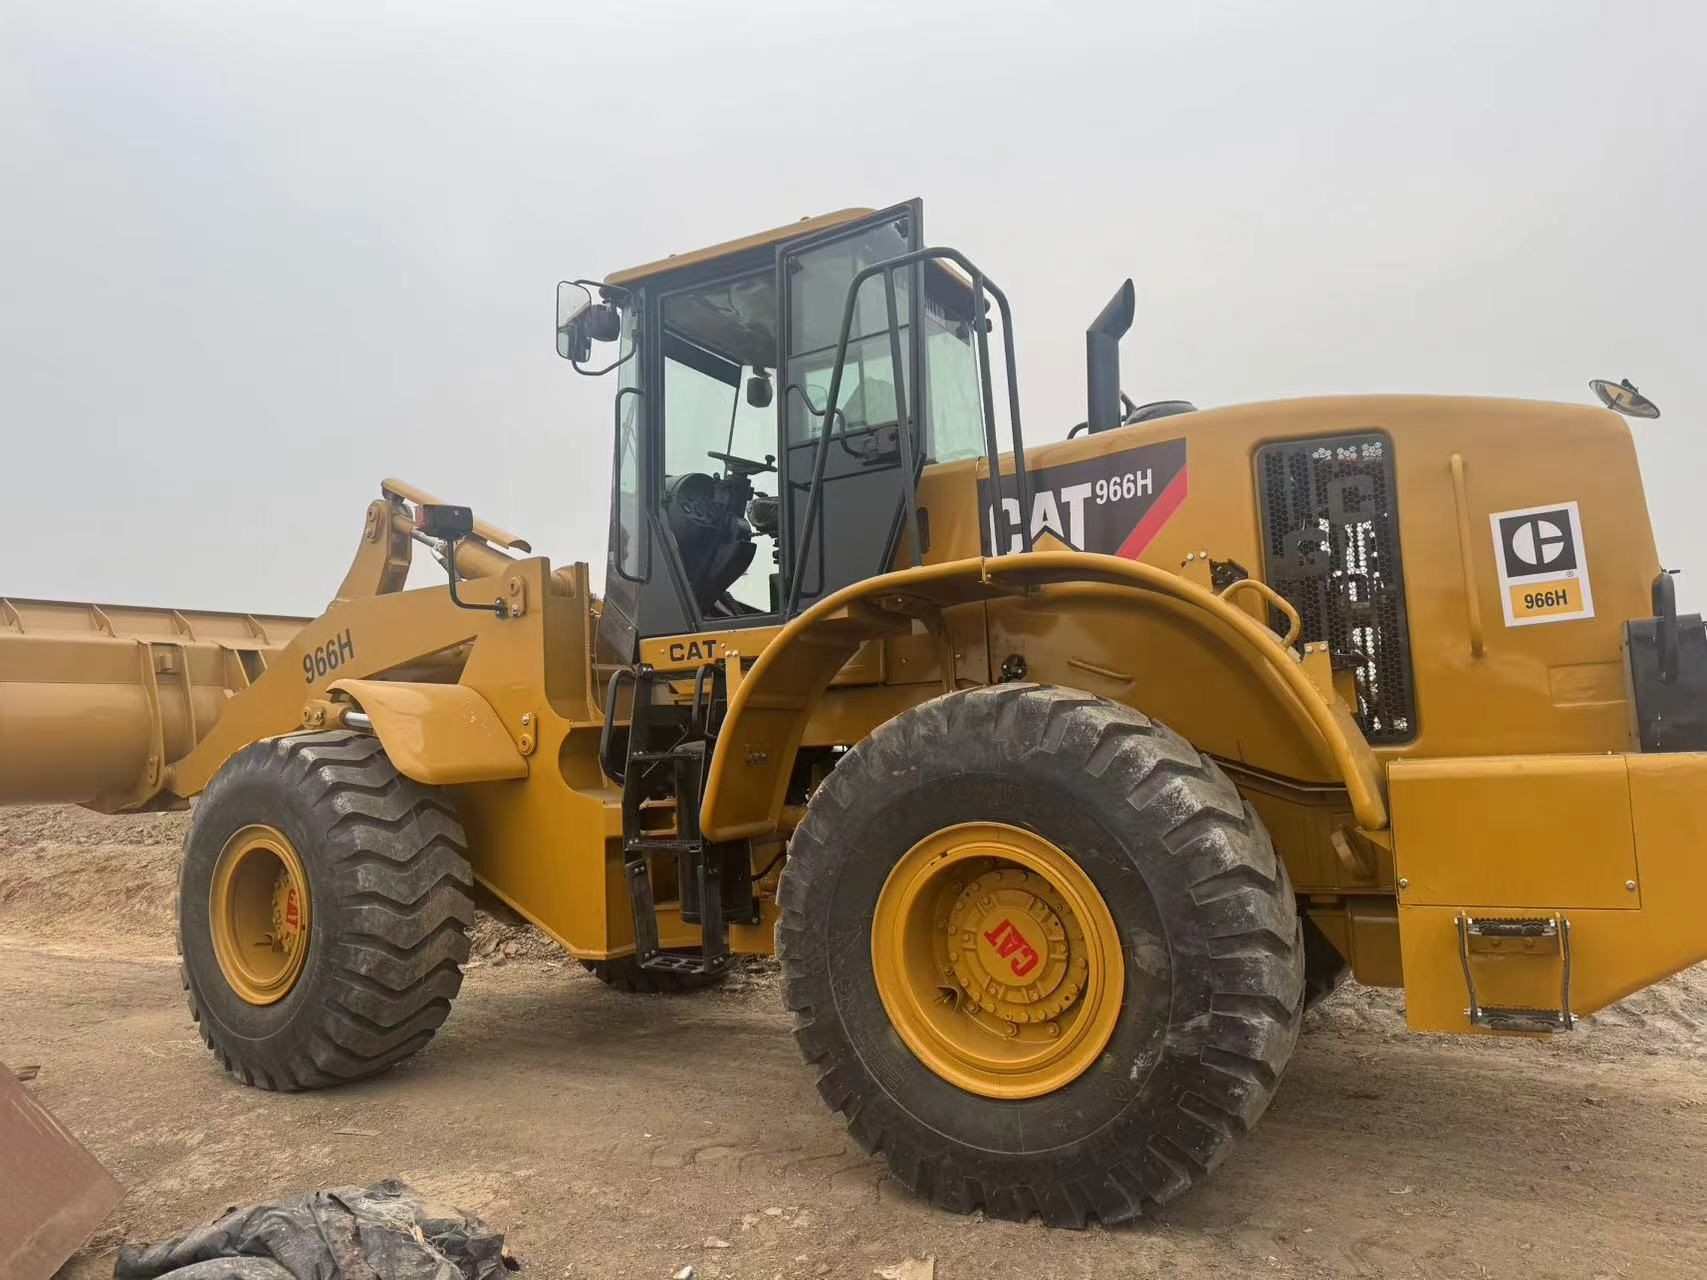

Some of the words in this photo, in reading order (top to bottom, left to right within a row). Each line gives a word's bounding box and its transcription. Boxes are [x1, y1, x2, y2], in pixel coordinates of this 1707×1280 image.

[988, 482, 1092, 557] CAT
[1095, 468, 1153, 505] 966H
[1524, 588, 1568, 609] 966H
[303, 628, 354, 684] 966H
[669, 640, 717, 661] CAT
[983, 918, 1039, 977] CAT
